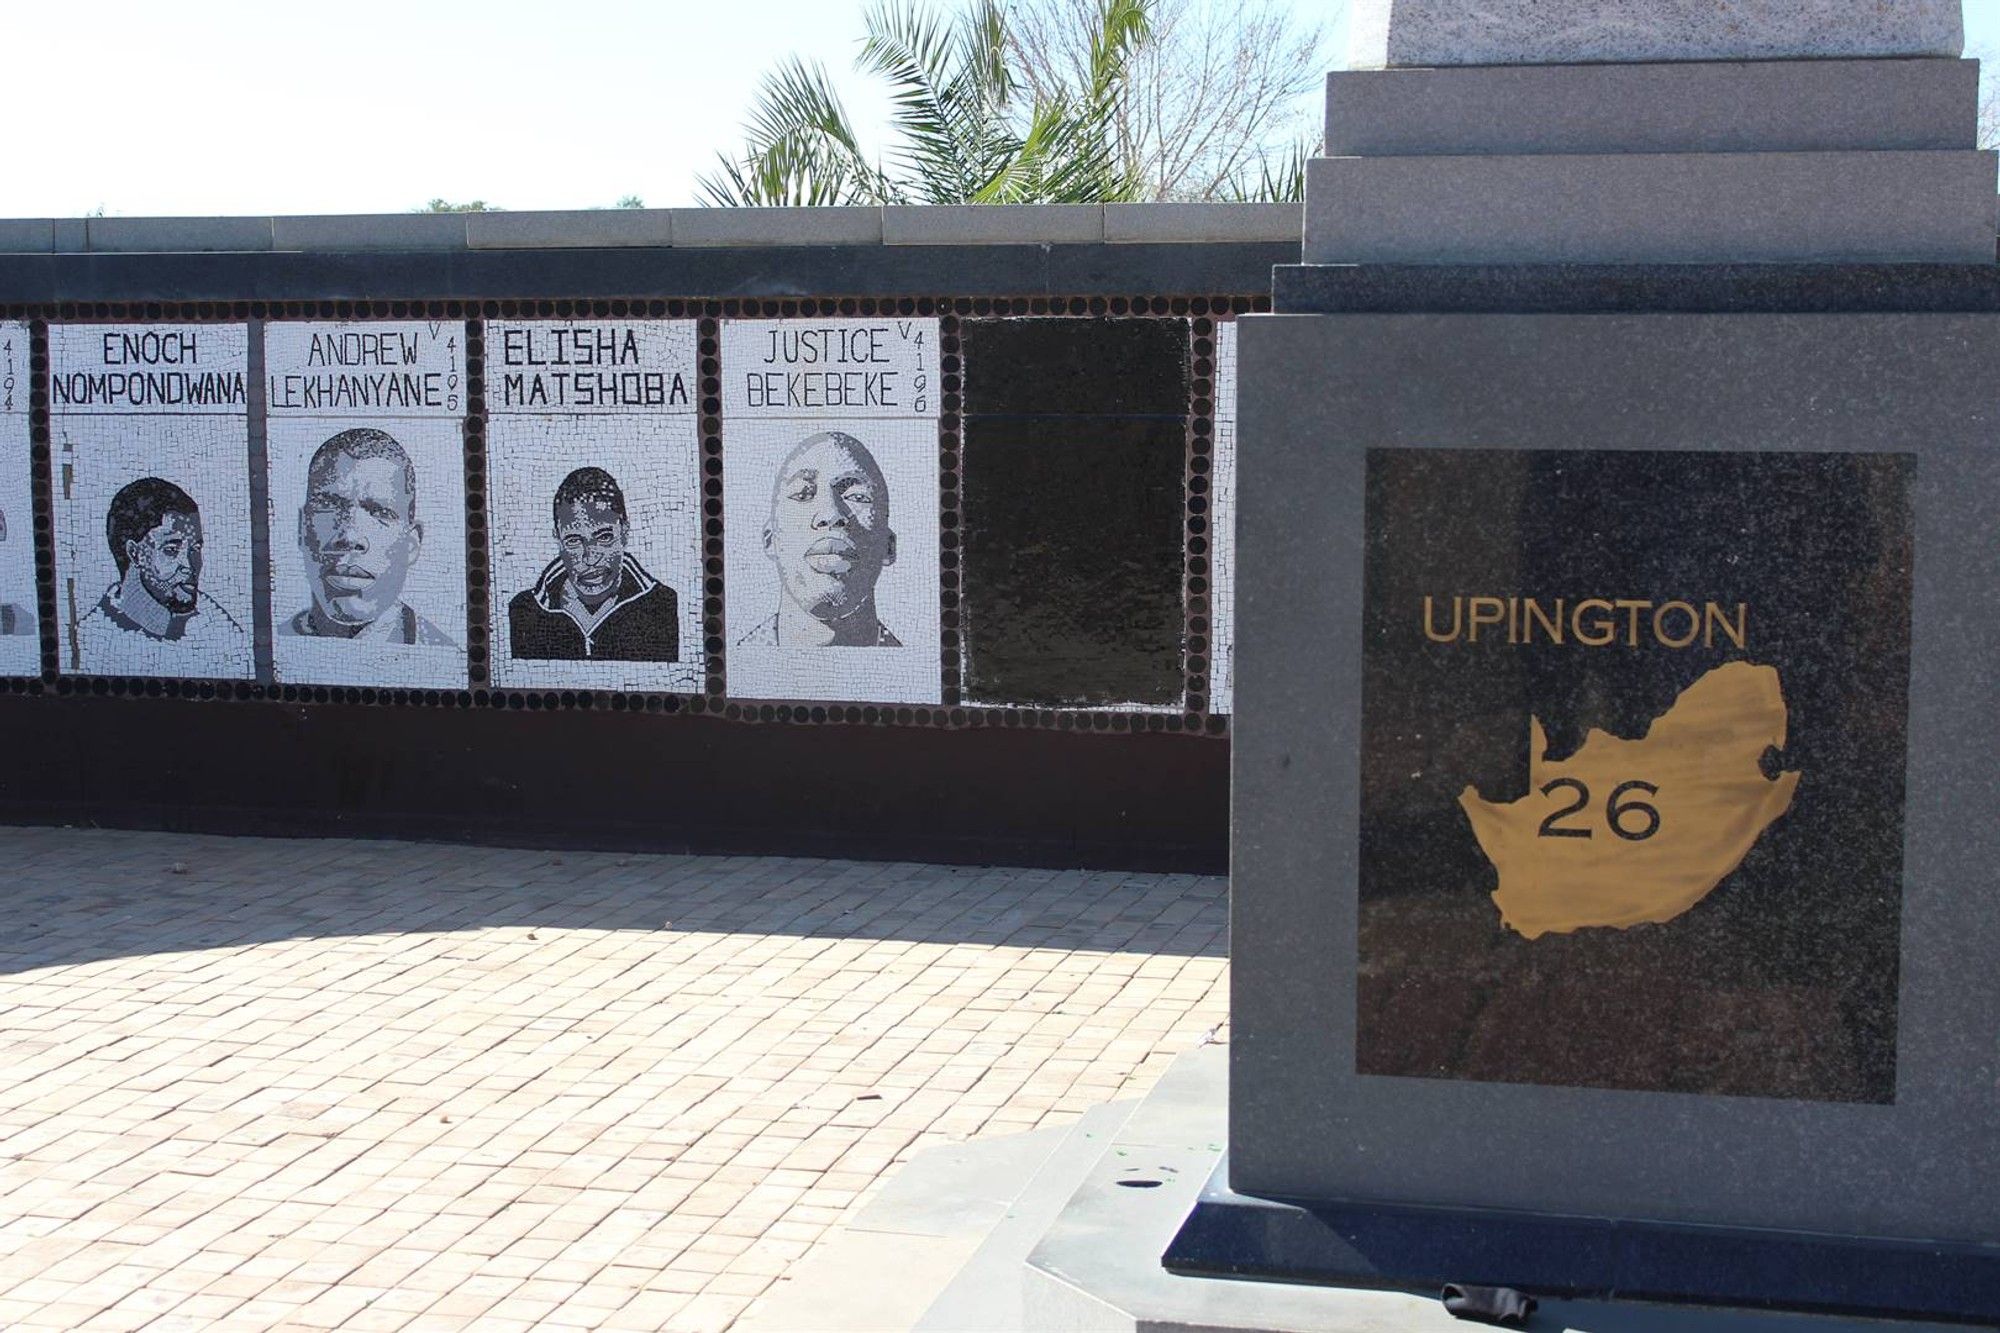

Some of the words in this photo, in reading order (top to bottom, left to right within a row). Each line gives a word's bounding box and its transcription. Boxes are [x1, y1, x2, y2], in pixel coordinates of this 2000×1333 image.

[103, 331, 197, 365] ENOCH
[307, 332, 418, 367] ANDREW
[504, 328, 639, 366] ELISHA
[763, 328, 891, 364] JUSTICE
[52, 372, 246, 405] NOMPONDWANA
[270, 372, 442, 408] LEKHANYANE
[504, 372, 688, 406] MATSHOBA
[746, 371, 899, 408] BEKEBEKE
[1423, 595, 1748, 650] UPINGTON
[1537, 777, 1661, 841] 26
